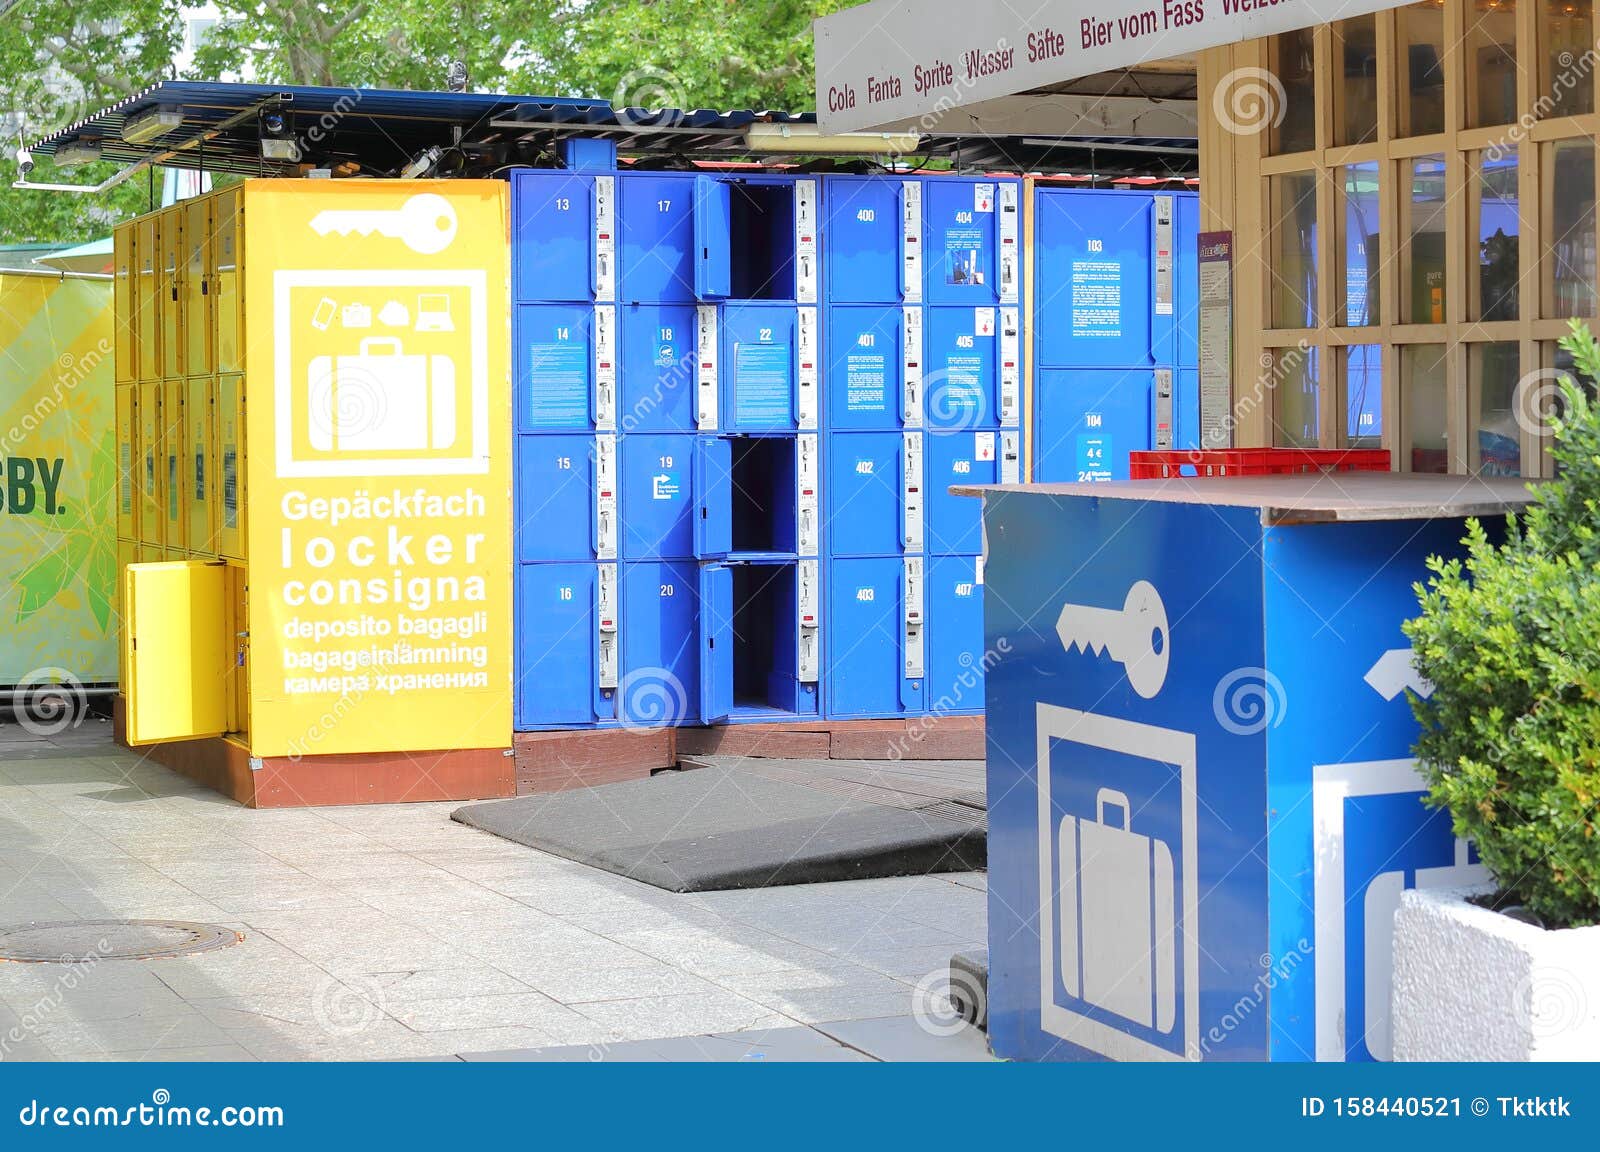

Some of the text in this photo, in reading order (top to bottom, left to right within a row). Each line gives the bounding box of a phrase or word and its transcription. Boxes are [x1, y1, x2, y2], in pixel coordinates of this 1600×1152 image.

[828, 83, 856, 112] Cola
[867, 75, 902, 104] Fanta
[914, 59, 953, 97] Sprite
[965, 47, 1014, 80] Wasser
[1027, 28, 1065, 63] Säfte
[1080, 16, 1114, 49] Bier
[1118, 10, 1157, 40] vom
[1163, 0, 1205, 29] Fass
[556, 198, 570, 211] 13
[657, 200, 671, 213] 17
[857, 209, 874, 222] 400
[955, 211, 972, 224] 404
[1087, 239, 1103, 252] 103
[557, 327, 569, 340] 14
[661, 328, 672, 341] 18
[759, 328, 772, 341] 22
[857, 334, 875, 347] 401
[956, 335, 973, 348] 405
[1086, 414, 1102, 427] 104
[1086, 448, 1103, 458] 4 €
[557, 457, 570, 469] 15
[659, 456, 673, 468] 19
[856, 461, 873, 474] 402
[953, 461, 970, 473] 406
[1078, 471, 1092, 482] 24
[281, 488, 486, 527] Gepäckfach
[281, 525, 486, 569] locker
[282, 570, 487, 611] consigna
[559, 587, 572, 600] 16
[660, 585, 674, 596] 20
[856, 588, 874, 601] 403
[955, 583, 972, 596] 407
[283, 612, 488, 643] deposito bagagli
[283, 643, 488, 673] bagageinlämning
[284, 671, 488, 697] камера хранения
